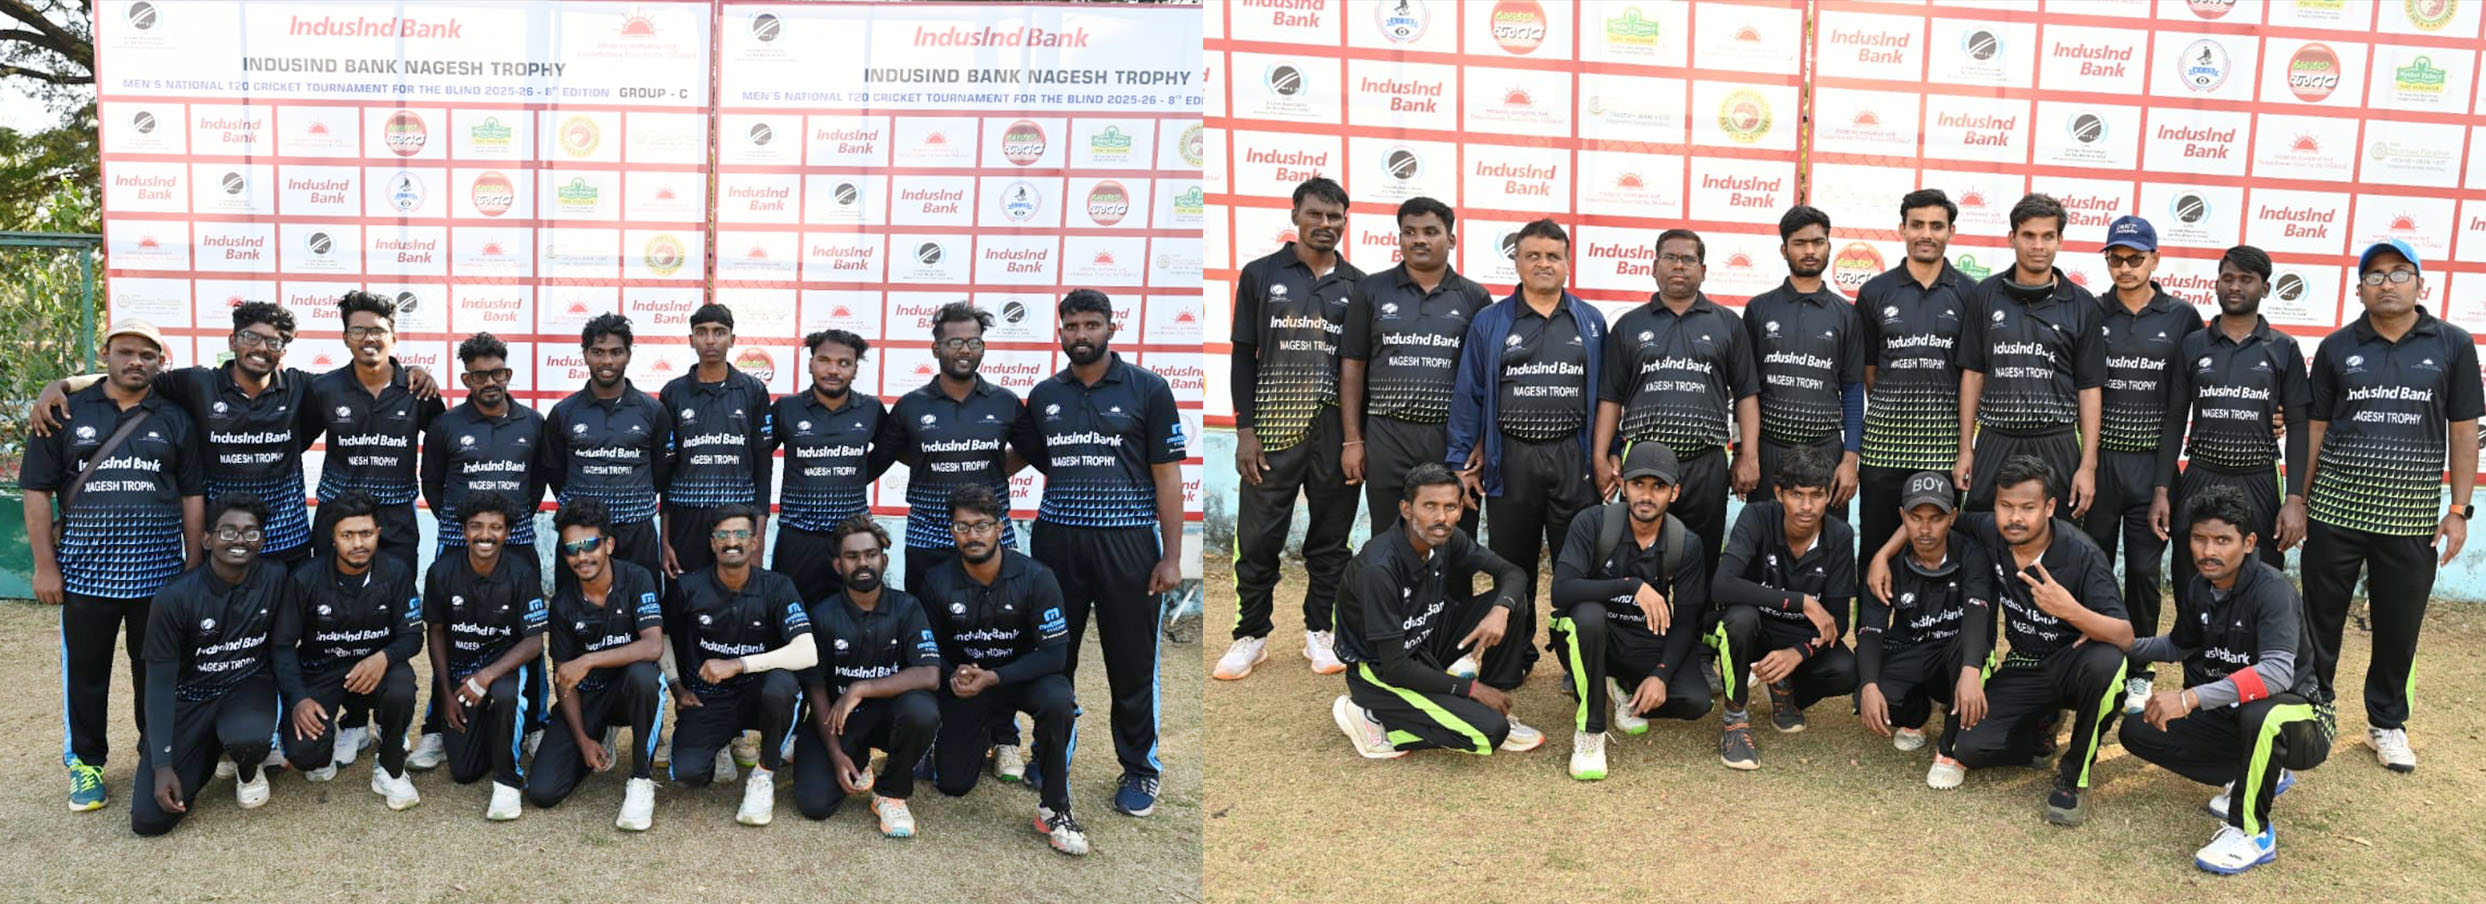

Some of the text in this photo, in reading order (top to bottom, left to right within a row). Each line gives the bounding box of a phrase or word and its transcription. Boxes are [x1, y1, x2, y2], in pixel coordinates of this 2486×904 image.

[289, 15, 463, 38] IndusInd Bank
[1273, 12, 1320, 28] Bank
[914, 26, 1088, 48] IndusInd Bank
[1830, 29, 1910, 48] IndusInd
[1858, 47, 1903, 65] Bank
[2053, 42, 2132, 61] IndusInd
[243, 57, 566, 77] INDUSIND BANK NAGESH TROPHY
[2080, 62, 2125, 78] Bank
[864, 68, 1191, 86] INDUSIND BANK NAGESH TROPHY
[123, 79, 161, 89] MEN'S
[166, 80, 224, 91] NATIONAL
[229, 81, 249, 91] T20
[253, 82, 301, 92] CRICKET
[307, 83, 387, 94] TOURNAMENT
[392, 84, 415, 94] FOR
[419, 84, 441, 95] THE
[445, 85, 481, 95] BLIND
[485, 86, 533, 96] 2025-26
[562, 87, 610, 97] EDITION
[619, 88, 665, 98] GROUP
[679, 89, 688, 99] C
[1361, 77, 1442, 96] IndusInd
[742, 91, 781, 101] MEN'S
[785, 91, 842, 102] NATIONAL
[848, 92, 869, 102] T20
[873, 92, 921, 102] CRICKET
[926, 93, 1009, 103] TOURNAMENT
[1013, 94, 1036, 104] FOR
[1041, 94, 1064, 104] THE
[1067, 94, 1103, 104] BLIND
[1107, 95, 1156, 105] 2025-26
[1390, 97, 1437, 113] Bank
[200, 117, 261, 131] IndusInd
[1937, 111, 2015, 130] IndusInd
[222, 131, 257, 144] Bank
[816, 129, 878, 141] IndusInd
[1964, 131, 2008, 147] Bank
[2157, 124, 2236, 143] IndusInd
[838, 142, 873, 154] Bank
[2184, 143, 2229, 159] Bank
[1246, 148, 1327, 167] IndusInd
[1476, 161, 1556, 180] IndusInd
[115, 174, 176, 188] IndusInd
[288, 179, 349, 192] IndusInd
[1702, 173, 1781, 192] IndusInd
[138, 188, 172, 200] Bank
[728, 185, 789, 199] IndusInd
[901, 188, 963, 201] IndusInd
[1504, 181, 1551, 196] Bank
[310, 192, 345, 204] Bank
[1729, 193, 1775, 208] Bank
[750, 200, 784, 212] Bank
[922, 201, 958, 214] Bank
[2068, 211, 2112, 228] Bank
[2258, 205, 2335, 223] IndusInd
[2283, 223, 2327, 239] Bank
[203, 235, 264, 248] IndusInd
[375, 238, 436, 251] IndusInd
[225, 248, 260, 261] Bank
[397, 251, 432, 264] Bank
[812, 245, 873, 258] IndusInd
[985, 247, 1047, 261] IndusInd
[833, 258, 868, 270] Bank
[1007, 261, 1043, 273] Bank
[461, 297, 521, 311] IndusInd
[632, 299, 692, 312] IndusInd
[483, 310, 518, 323] Bank
[653, 312, 688, 325] Bank
[1270, 315, 1321, 329] IndusInd
[1280, 340, 1311, 350] NAGESH
[1383, 332, 1460, 349] IndusInd Bank
[1887, 333, 1954, 349] IndusInd Bank
[980, 362, 1040, 375] IndusInd
[1389, 356, 1452, 368] NAGESH TROPHY
[1506, 361, 1584, 376] IndusInd Bank
[1687, 357, 1712, 375] Bank
[1807, 353, 1833, 370] Bank
[1918, 358, 1945, 369] TROPHY
[2139, 356, 2166, 371] Bank
[1995, 367, 2024, 378] NAGESH
[1001, 375, 1035, 388] Bank
[1675, 381, 1706, 393] TROPHY
[1767, 374, 1824, 390] NAGESH TROPHY
[2128, 379, 2157, 391] TROPHY
[1513, 386, 1579, 398] NAGESH TROPHY
[2199, 384, 2270, 401] IndusInd Bank
[2400, 386, 2434, 402] Bank
[2202, 408, 2259, 421] NAGESH TROPHY
[2386, 412, 2421, 425] TROPHY
[210, 429, 292, 443] IndusInd Bank
[381, 434, 407, 448] Bank
[723, 432, 746, 446] Bank
[1046, 431, 1123, 447] IndusInd Bank
[618, 447, 641, 458] Bank
[797, 445, 840, 458] IndusInd
[922, 438, 1000, 453] IndusInd Bank
[133, 457, 161, 473] Bank
[220, 452, 253, 465] NAGESH
[370, 455, 398, 466] TROPHY
[714, 454, 740, 465] TROPHY
[1051, 455, 1116, 467] NAGESH TROPHY
[463, 460, 504, 474] IndusInd
[804, 466, 857, 477] NAGESH TROPHY
[931, 460, 990, 473] NAGESH TROPHY
[84, 480, 120, 493] NAGESH
[468, 480, 520, 490] NAGESH TROPHY
[1912, 476, 1944, 493] BOY
[363, 626, 391, 640] Bank
[606, 632, 632, 646] Bank
[700, 640, 766, 655] IndusInd Bank
